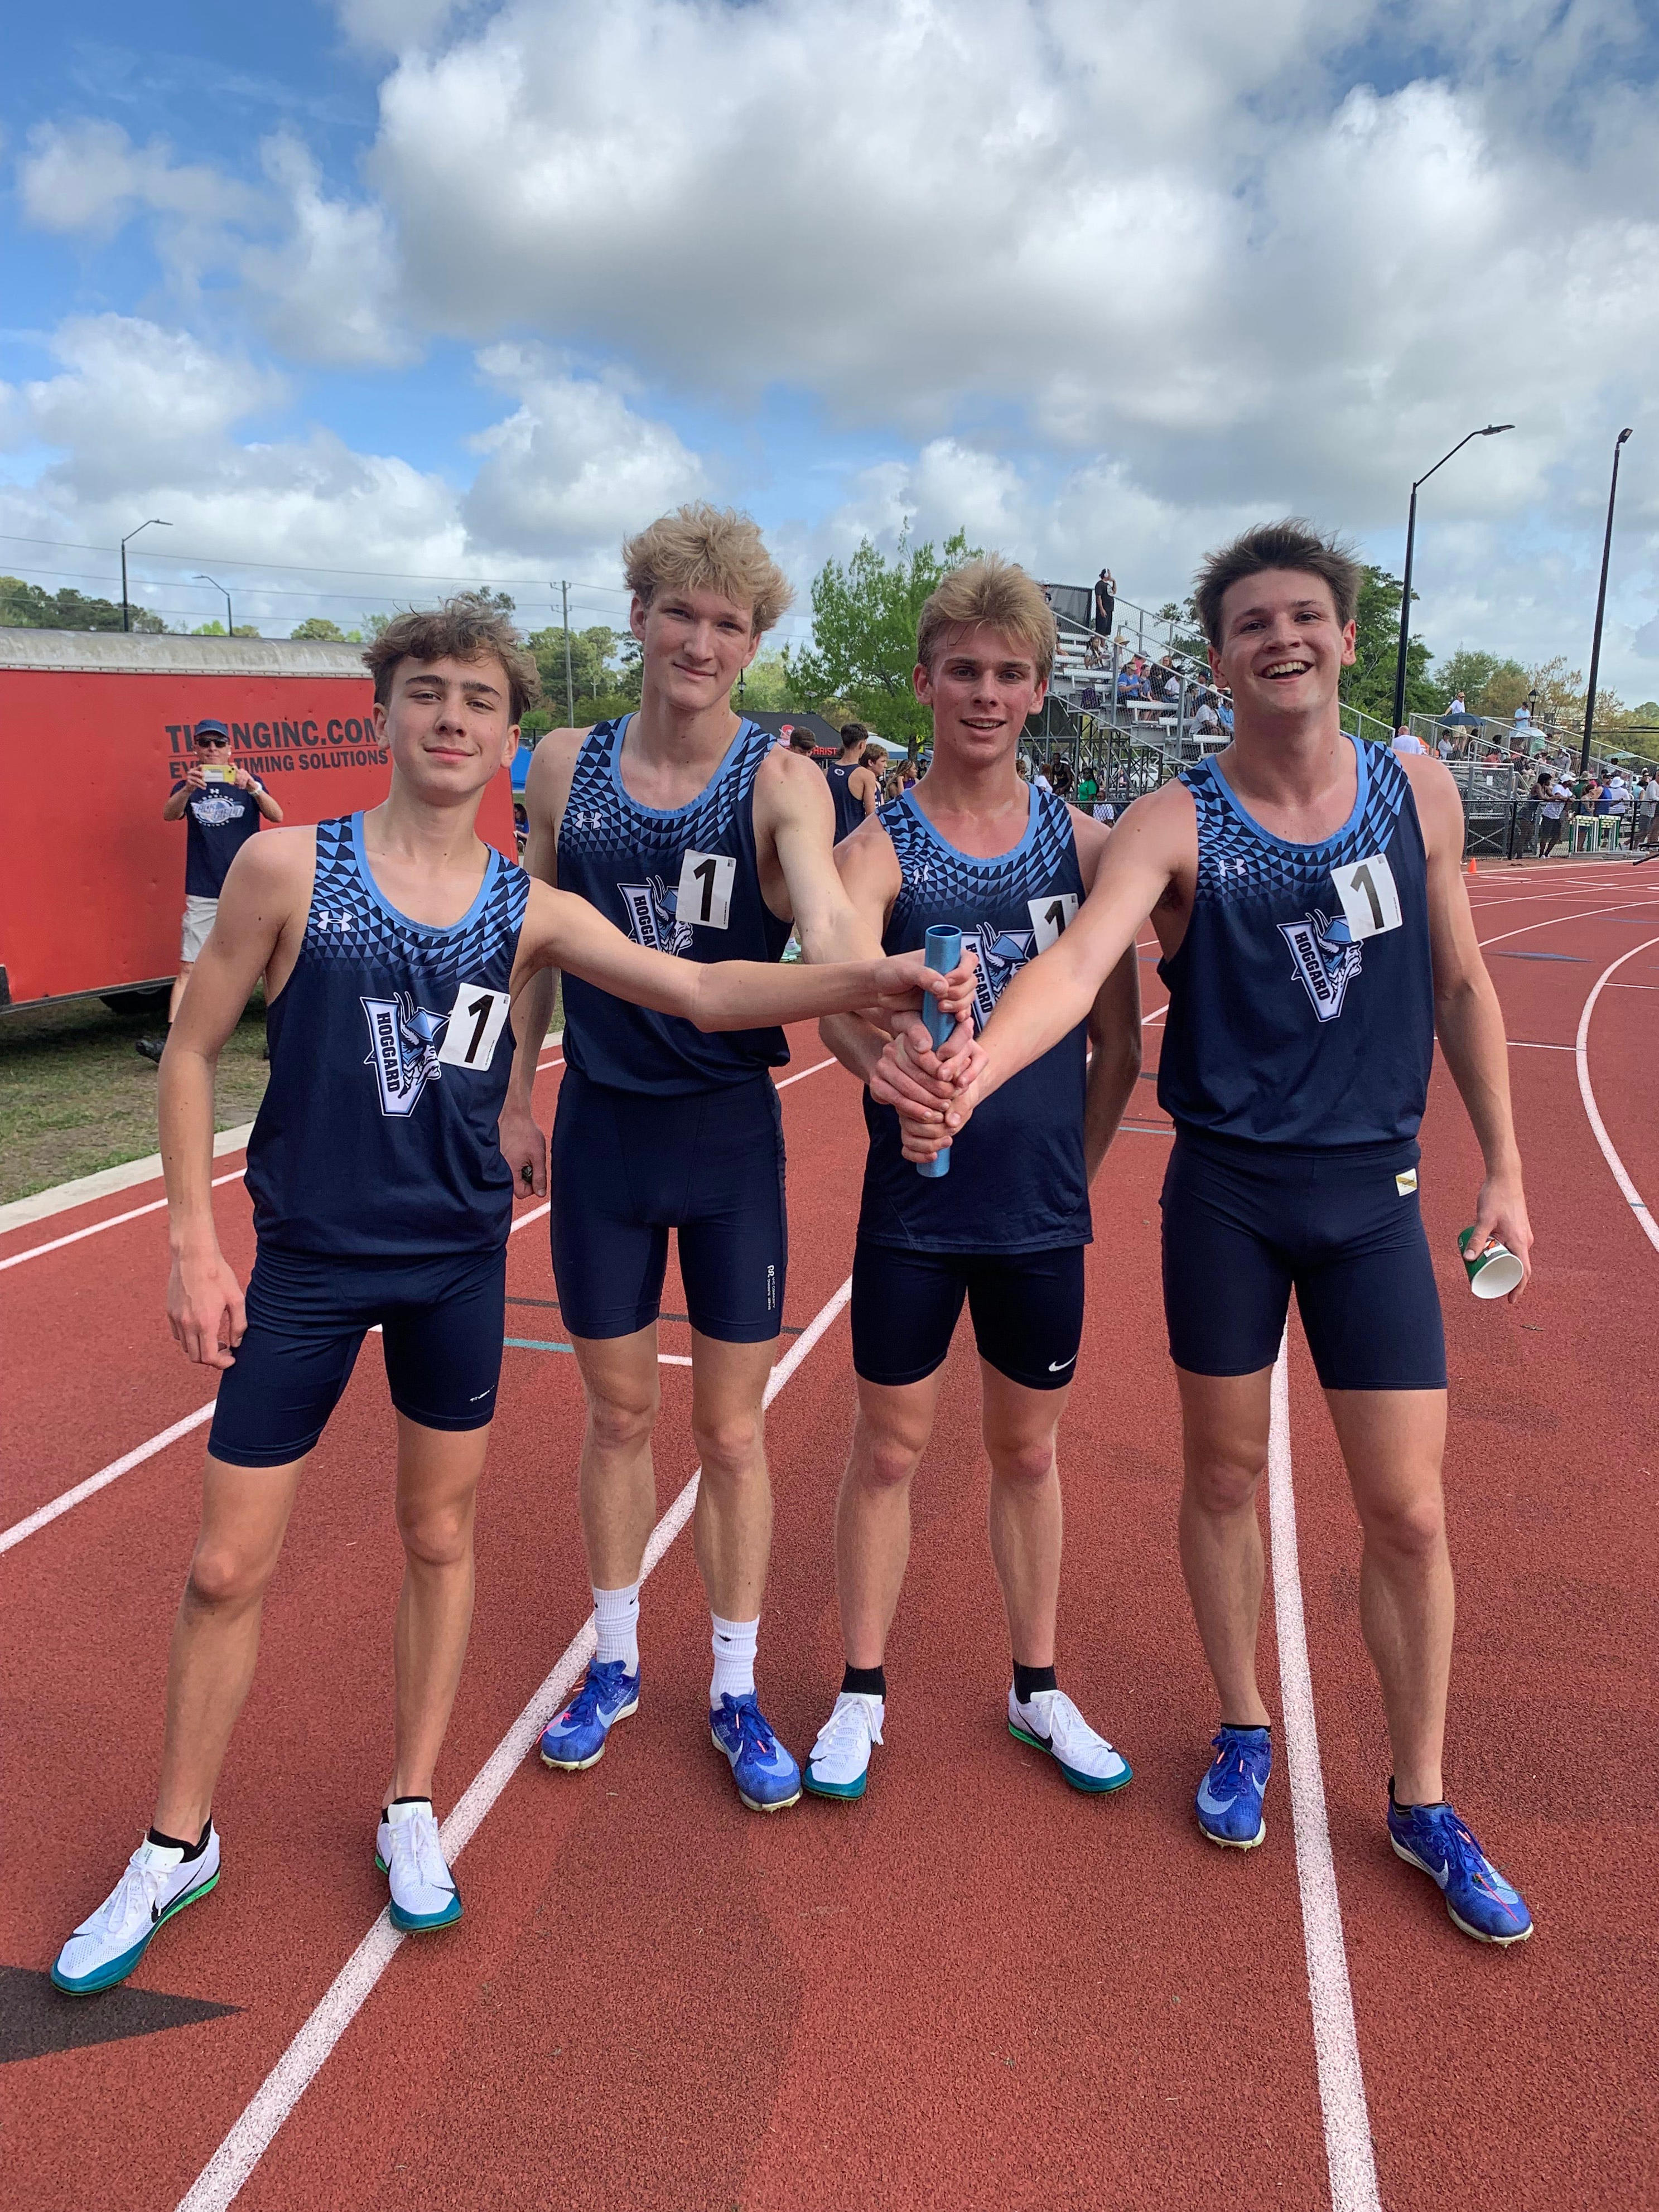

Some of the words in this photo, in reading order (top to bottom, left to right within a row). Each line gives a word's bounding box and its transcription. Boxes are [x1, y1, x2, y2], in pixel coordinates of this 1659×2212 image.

[165, 718, 376, 753] TINGINC.COM
[234, 755, 295, 774] TIMING
[300, 749, 388, 770] SOLUTIONS
[634, 895, 657, 949] HOGGA
[693, 858, 717, 922] 1
[1044, 900, 1066, 937] 1
[1350, 864, 1385, 930] 1
[966, 943, 993, 1013] HGGARD
[1294, 931, 1331, 1001] HOGGARD
[377, 1012, 400, 1092] HOGGARD
[467, 994, 495, 1064] 1
